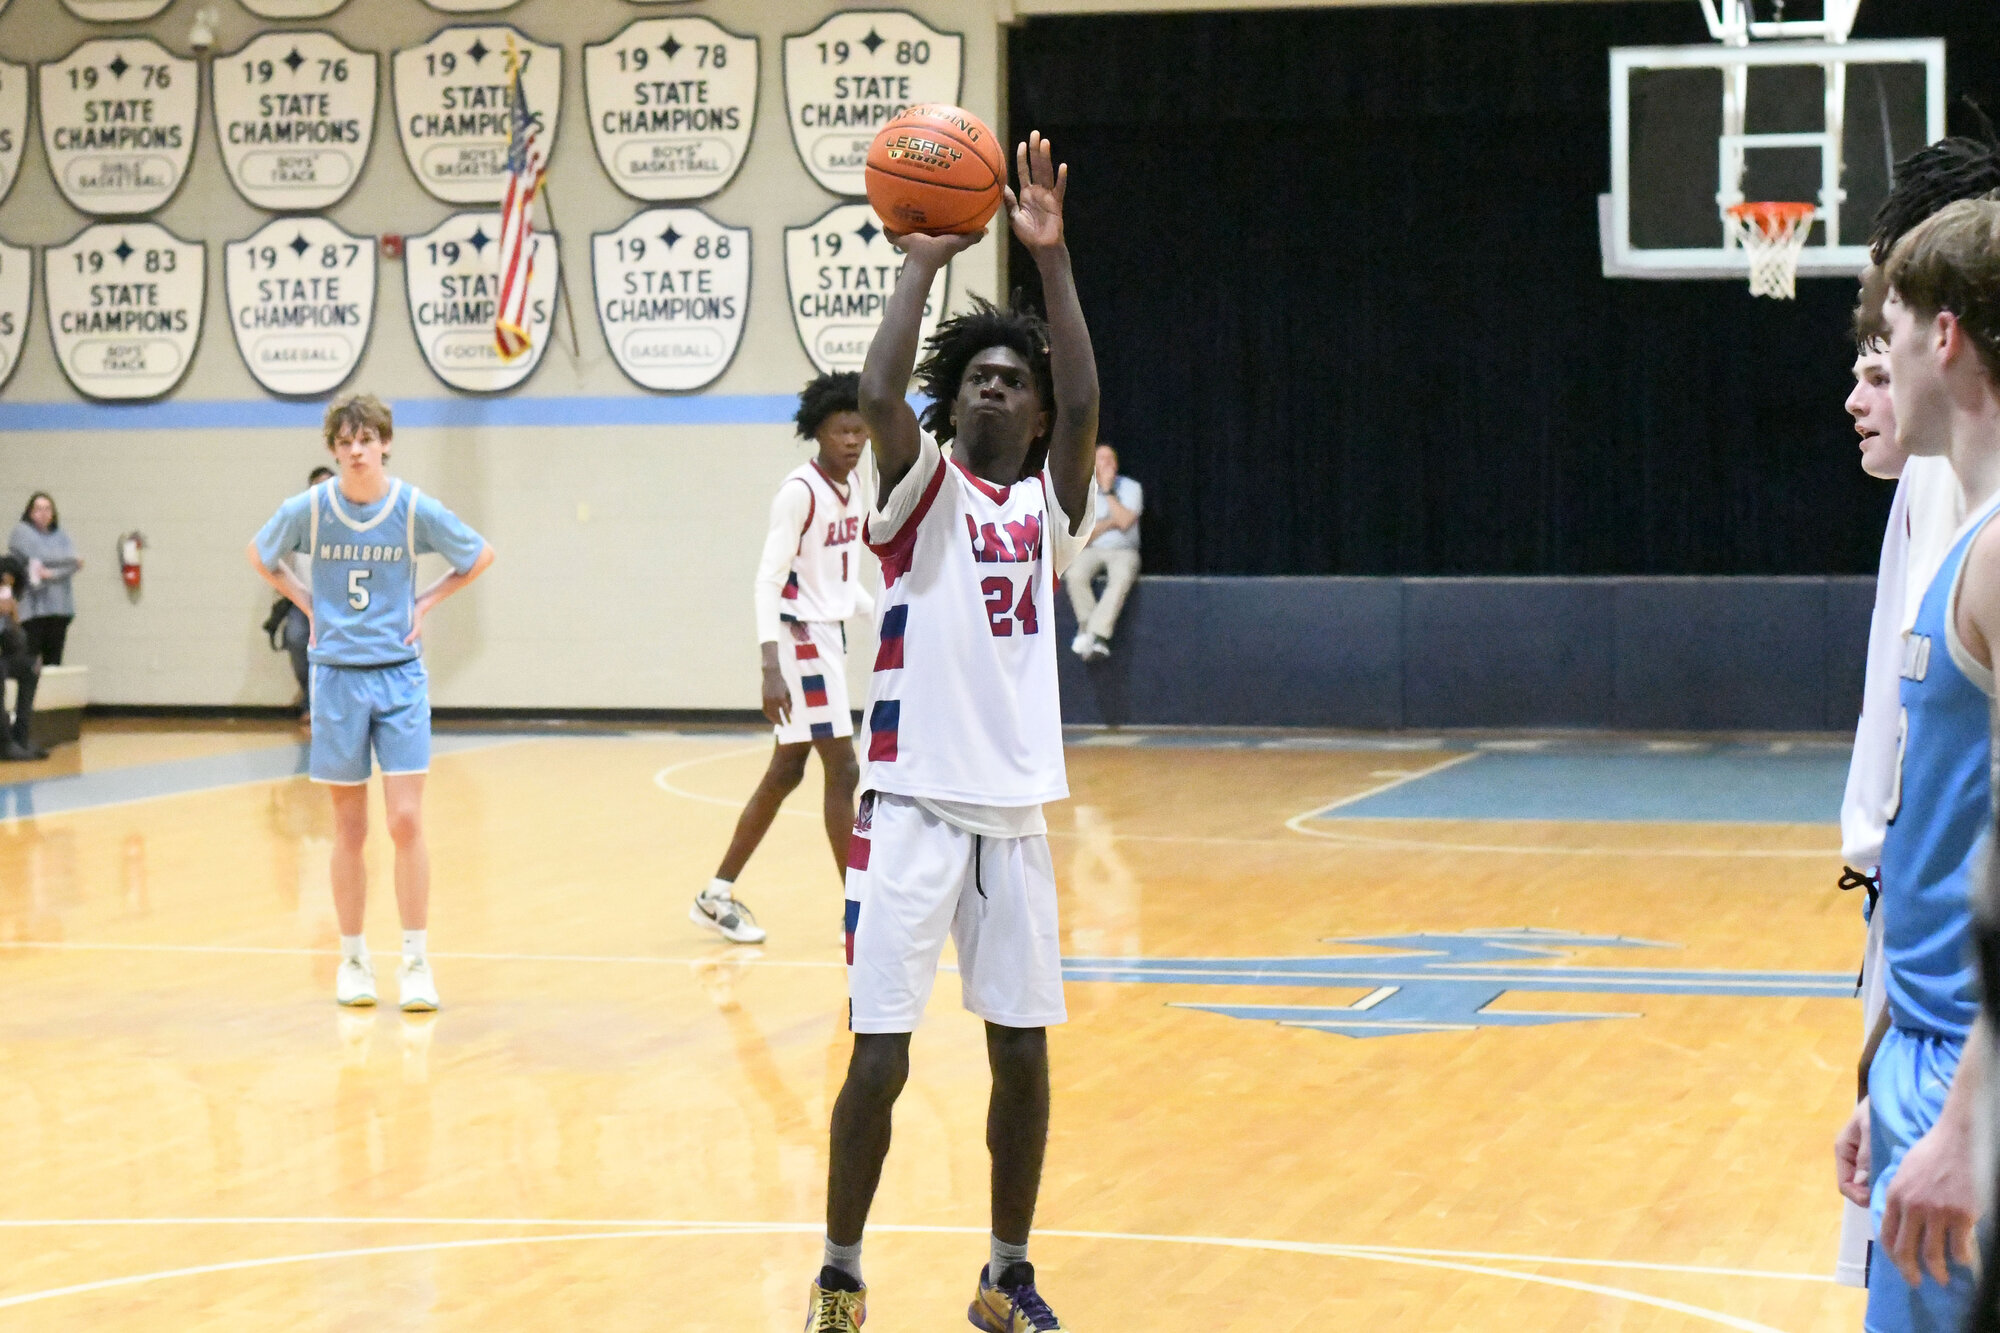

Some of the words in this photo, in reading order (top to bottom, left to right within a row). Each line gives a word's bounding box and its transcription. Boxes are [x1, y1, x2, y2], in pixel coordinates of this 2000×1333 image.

[425, 52, 456, 76] 19
[616, 48, 648, 72] 19
[695, 45, 727, 70] 78
[817, 41, 850, 66] 19
[896, 40, 931, 65] 80
[68, 67, 98, 91] 19
[141, 65, 171, 89] 76
[244, 60, 273, 84] 19
[318, 59, 349, 82] 76
[634, 80, 708, 105] STATE
[834, 76, 910, 99] STATE
[84, 99, 154, 122] STATE
[259, 94, 331, 118] STATE
[228, 120, 360, 145] CHAMPIONS
[603, 107, 740, 134] CHAMPIONS
[54, 124, 182, 150] CHAMPIONS
[885, 136, 963, 163] LEGACY
[630, 160, 719, 173] BASKETBALL
[247, 246, 277, 270] 19
[321, 244, 360, 268] 87
[427, 241, 461, 266] 19
[616, 238, 646, 262] 19
[694, 235, 732, 260] 88
[812, 234, 843, 257] 19
[74, 251, 104, 275] 19
[145, 250, 177, 274] 83
[90, 283, 159, 307] STATE
[258, 277, 340, 302] STATE
[441, 273, 499, 299] STAT
[624, 270, 712, 295] STATE
[60, 309, 188, 334] CHAMPIONS
[240, 304, 360, 329] CHAMPIONS
[418, 300, 546, 325] CHAMPS
[606, 297, 736, 323] CHAMPIONS
[320, 544, 403, 562] MARLBORO
[841, 551, 848, 582] 1
[348, 569, 372, 611] 5
[980, 575, 1039, 637] 24
